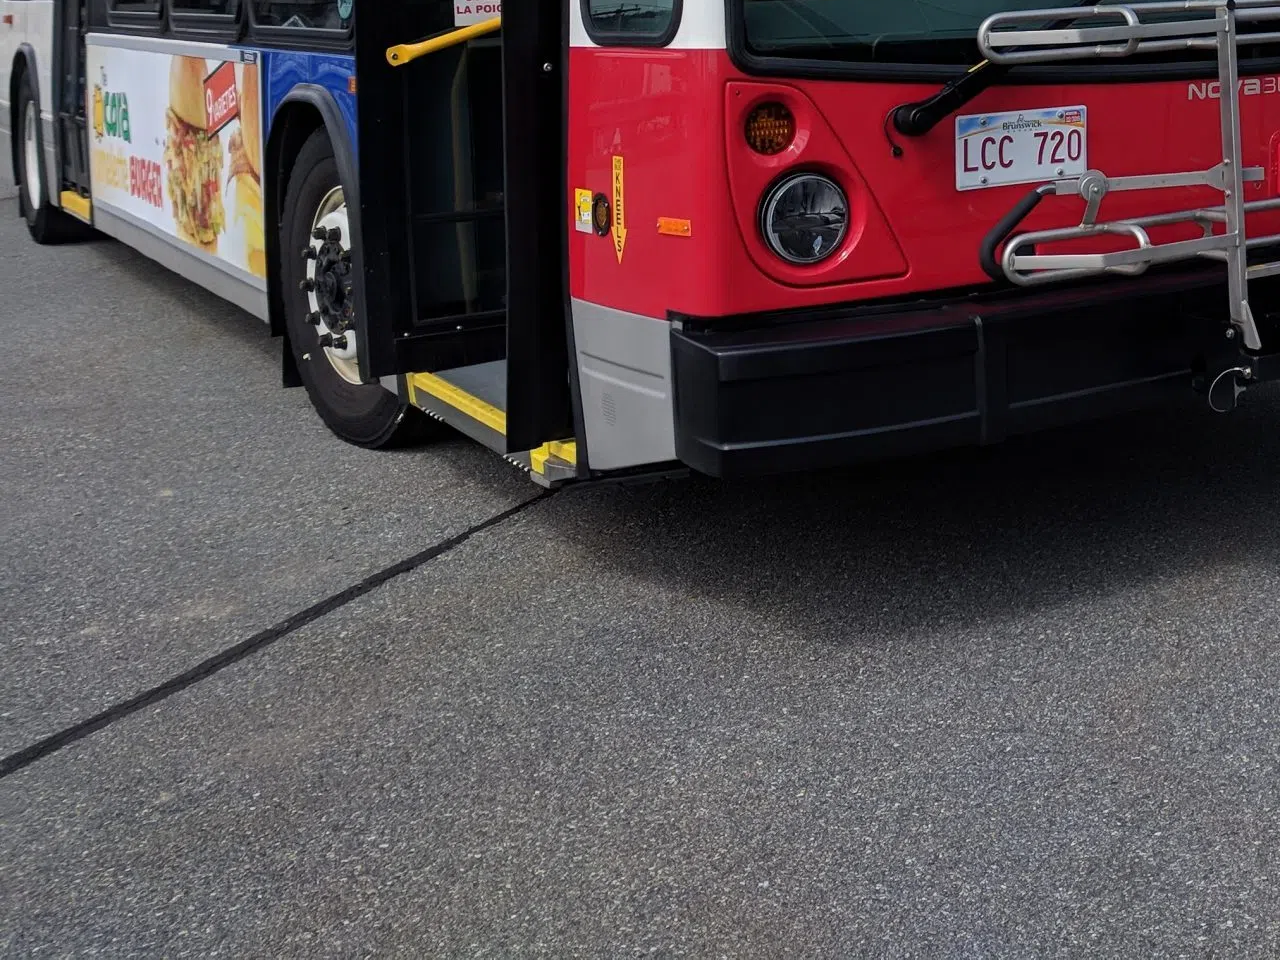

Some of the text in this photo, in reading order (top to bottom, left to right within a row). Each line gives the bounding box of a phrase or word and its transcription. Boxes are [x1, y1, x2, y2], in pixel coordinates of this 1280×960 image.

[456, 5, 472, 15] LA
[1002, 119, 1042, 131] Brunswick
[963, 128, 1082, 173] LCC 720
[614, 171, 623, 253] KNEELS
